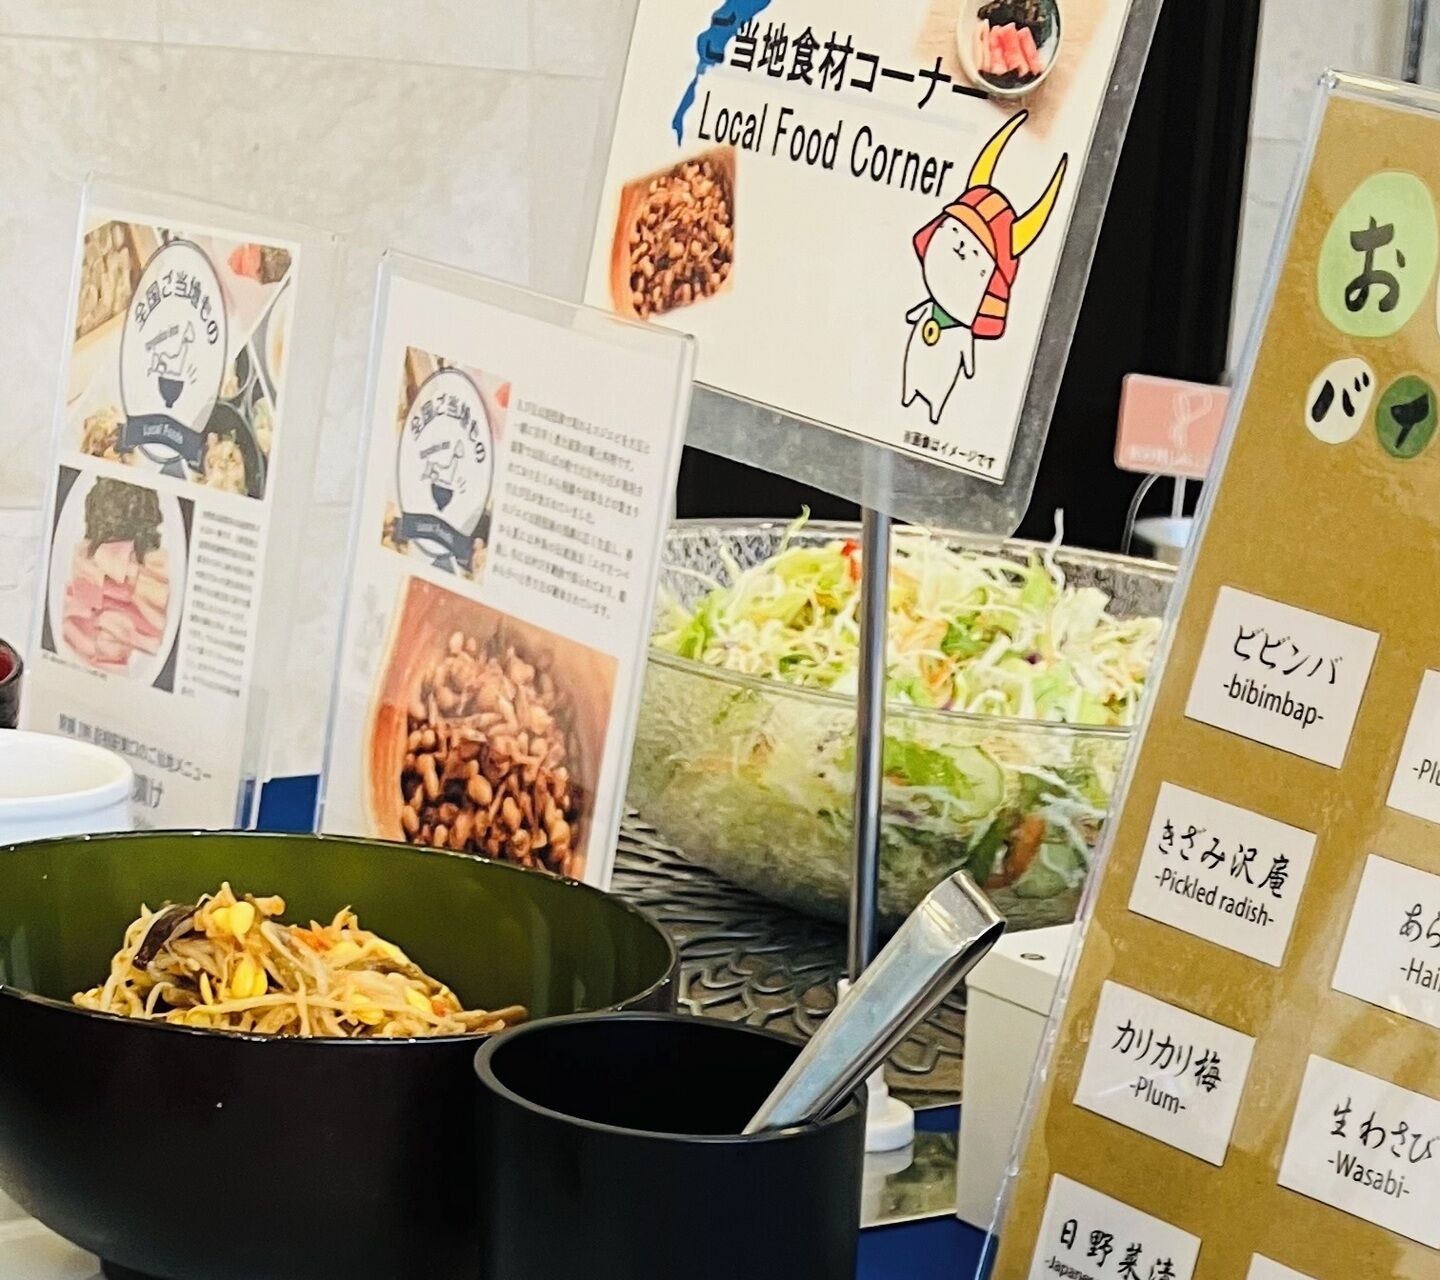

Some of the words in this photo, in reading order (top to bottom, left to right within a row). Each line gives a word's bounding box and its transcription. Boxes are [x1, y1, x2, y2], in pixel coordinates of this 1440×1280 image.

[698, 91, 769, 153] Local
[772, 106, 843, 170] Food
[851, 126, 955, 197] Corner
[1234, 625, 1343, 684] ビビンバ
[1223, 673, 1324, 729] -bibimbap-
[1158, 818, 1290, 899] きざみ沢庵
[1155, 868, 1219, 907] -Pickled
[1218, 896, 1275, 927] radish-
[1111, 1018, 1223, 1093] カリカリ梅
[1129, 1077, 1187, 1115] -Plum-
[1330, 1100, 1440, 1164] 生わさび
[1327, 1153, 1410, 1199] -Wasabi-
